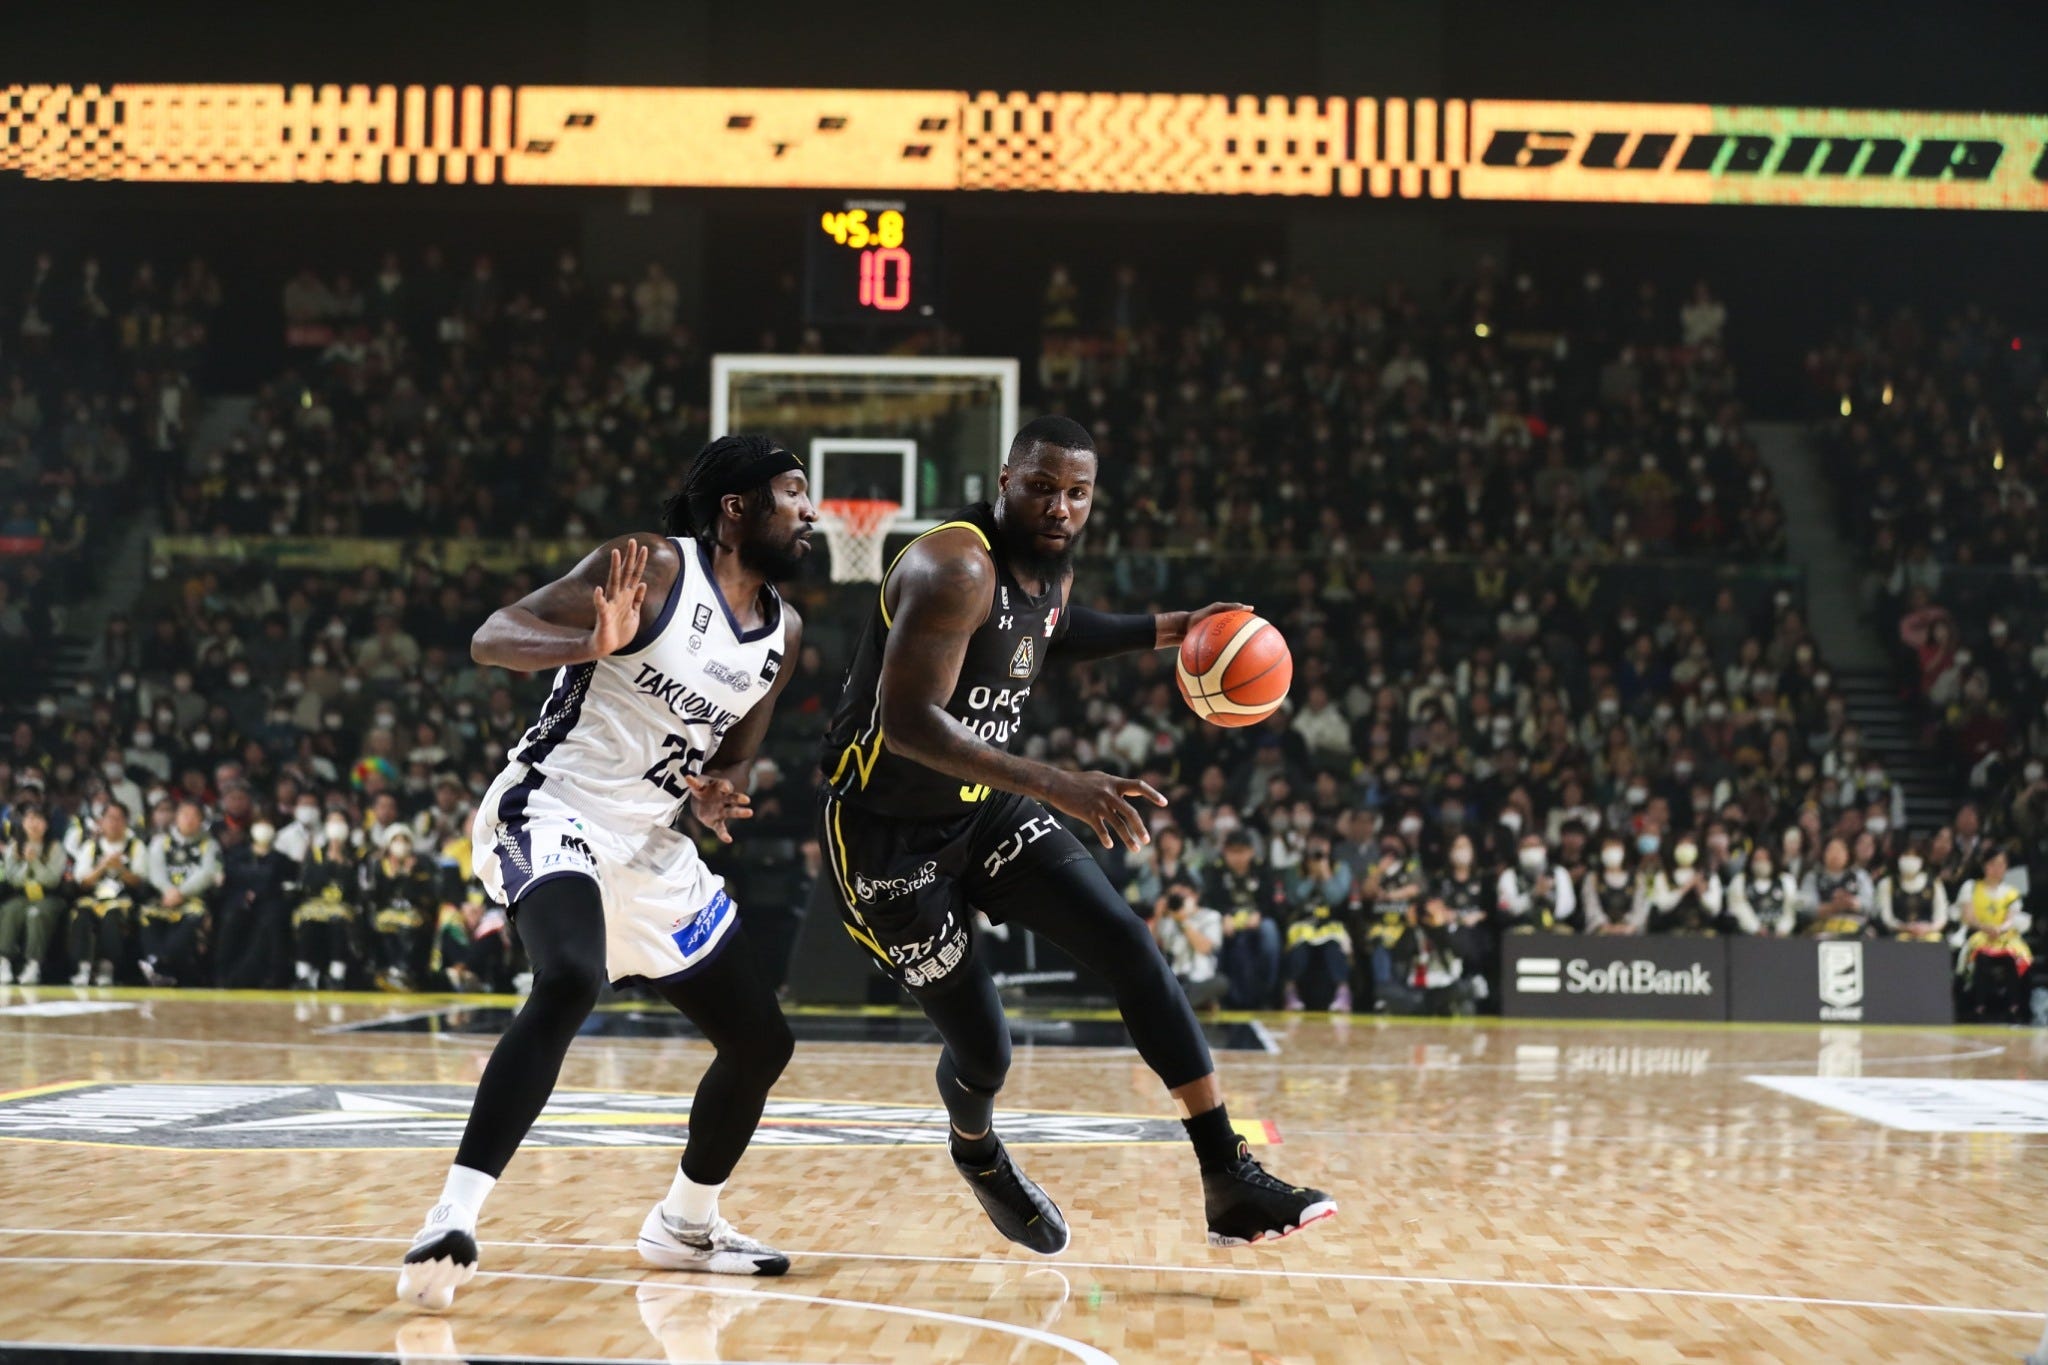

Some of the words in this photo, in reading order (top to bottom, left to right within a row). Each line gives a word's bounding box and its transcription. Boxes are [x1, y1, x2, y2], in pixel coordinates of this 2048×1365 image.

[822, 208, 904, 248] 45.8
[860, 247, 911, 311] 10
[1566, 958, 1714, 996] SoftBank
